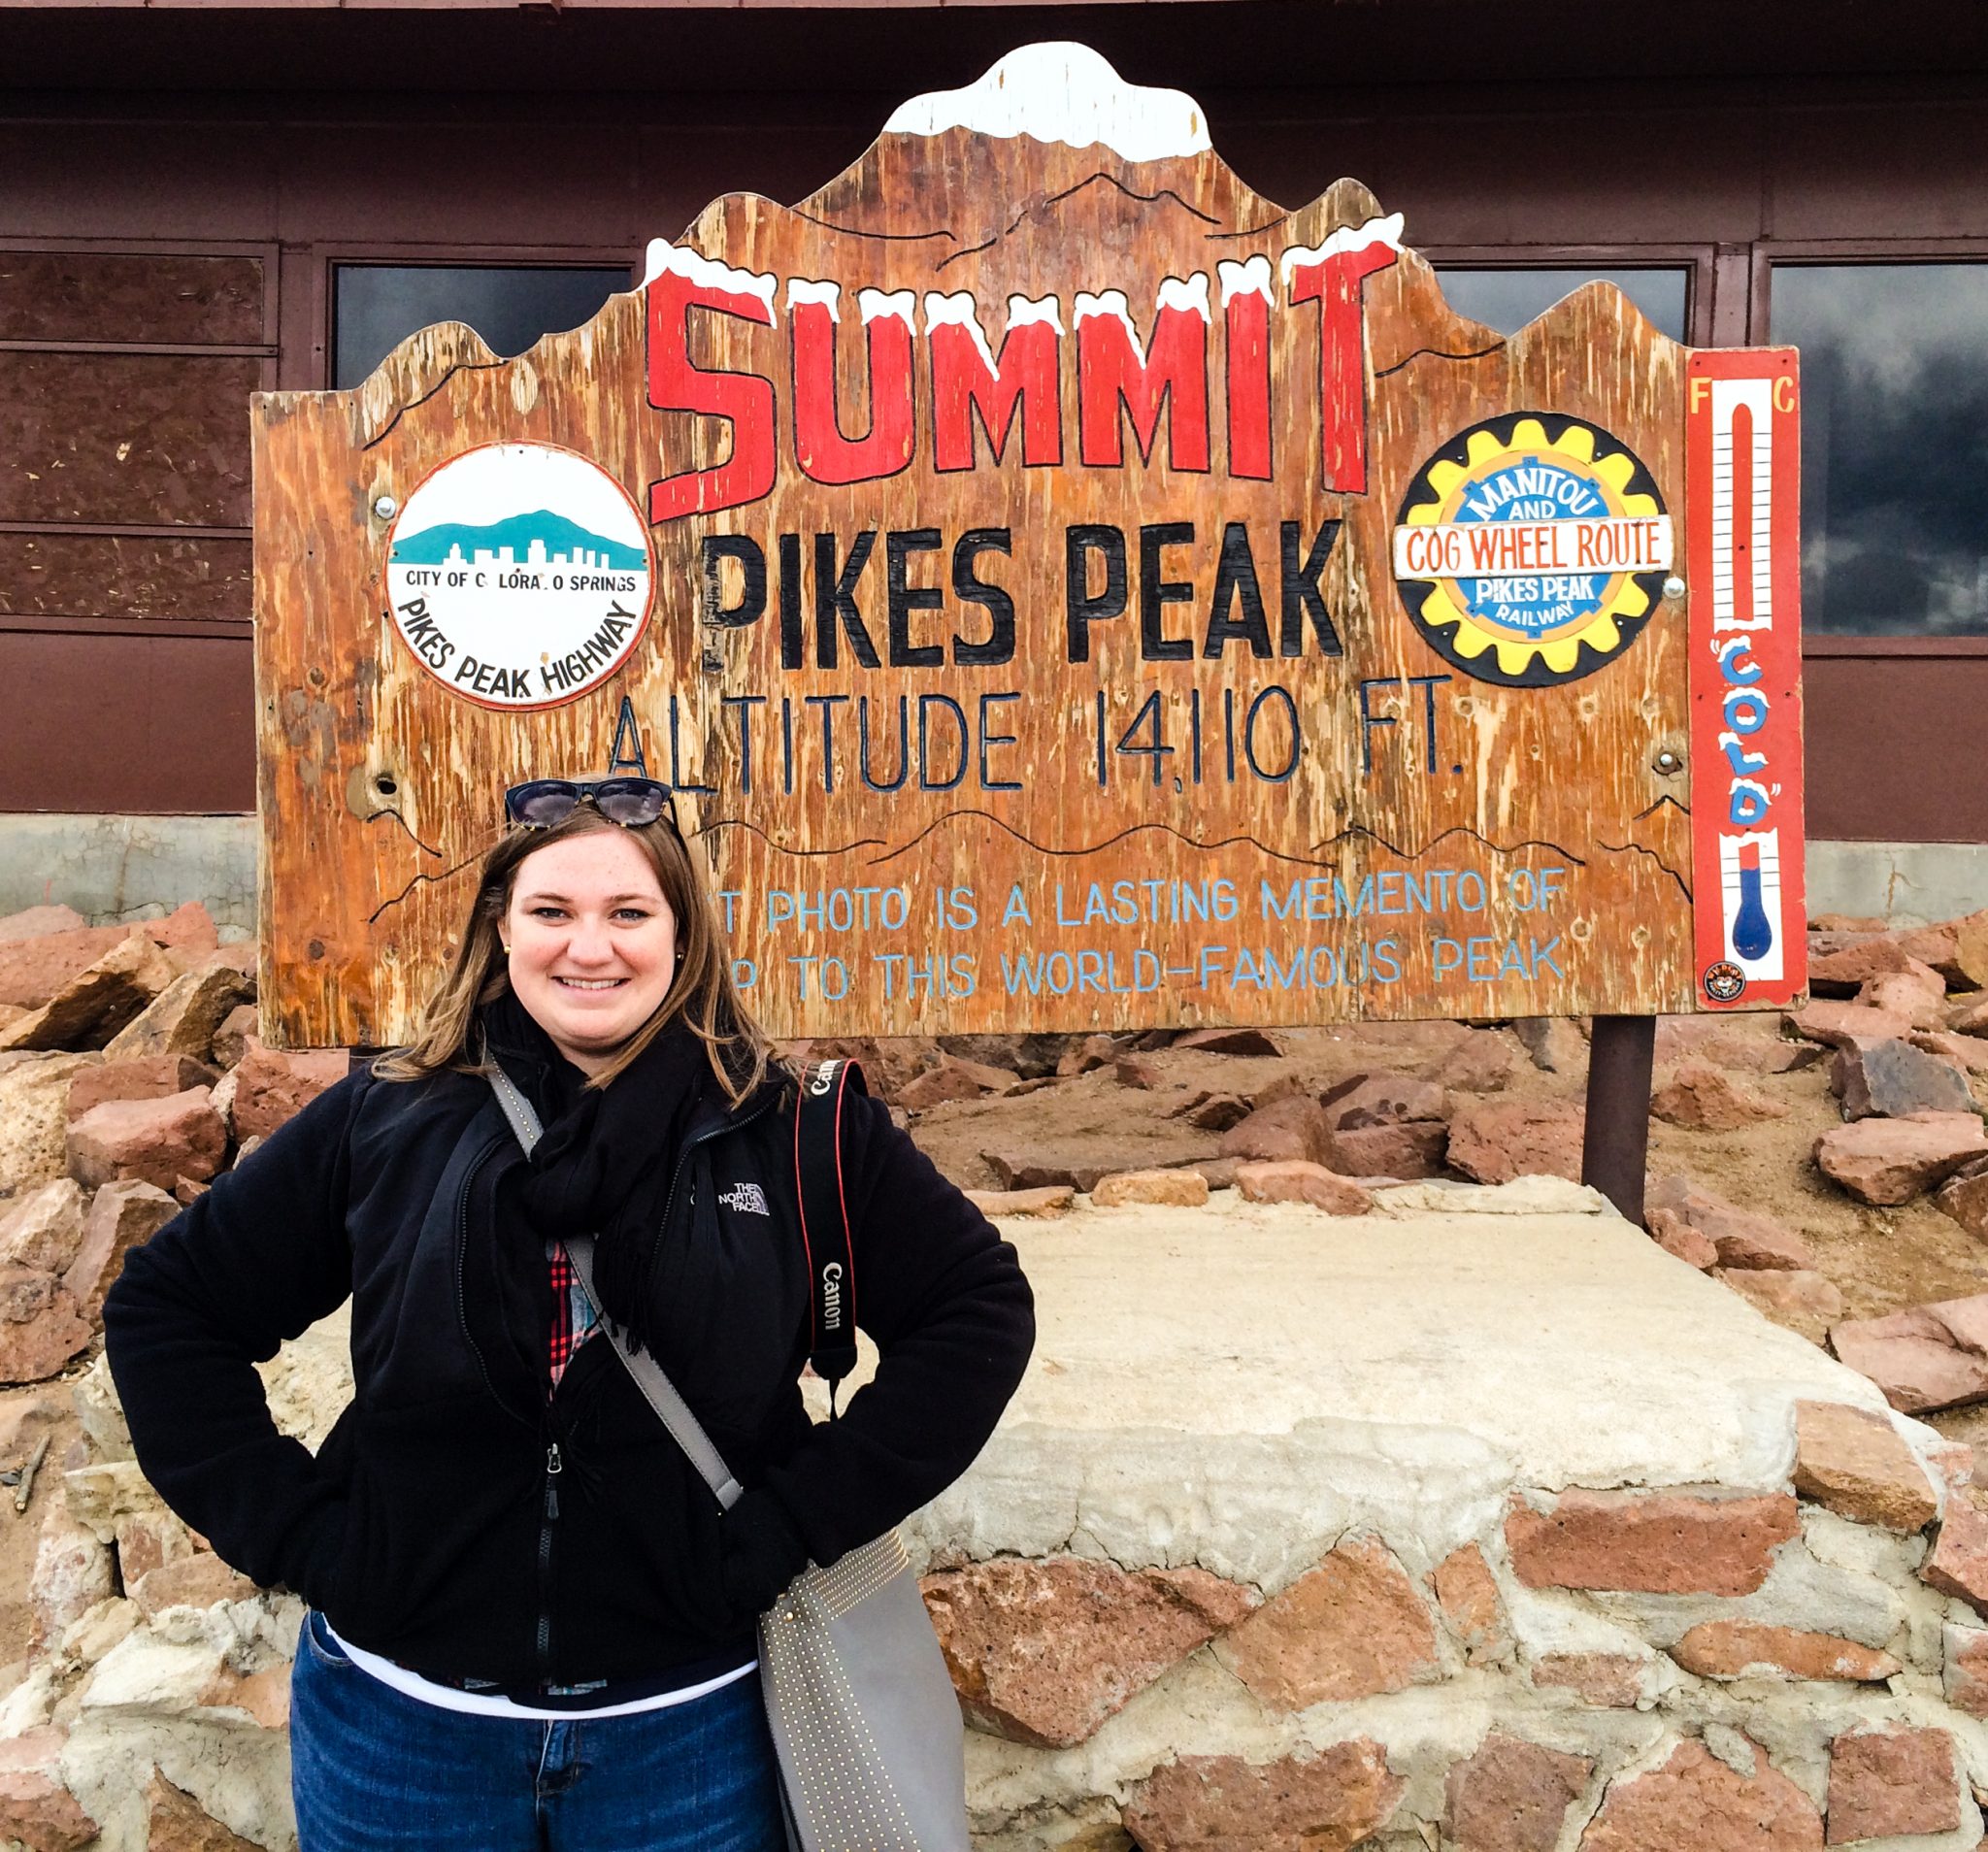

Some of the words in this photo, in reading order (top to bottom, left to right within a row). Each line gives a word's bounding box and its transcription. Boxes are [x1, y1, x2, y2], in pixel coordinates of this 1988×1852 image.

[645, 214, 1404, 525] SUMMIT
[1691, 377, 1711, 414] F
[1773, 376, 1795, 413] C
[1467, 467, 1599, 522] MANITOU
[1508, 501, 1556, 520] AND
[1407, 531, 1461, 572] COG
[1467, 525, 1568, 571] WHEEL
[1577, 521, 1662, 568] ROUTE
[406, 570, 442, 586] CITY
[447, 572, 468, 587] OF
[476, 572, 564, 590] CLORAO
[570, 576, 637, 592] SPRINGS
[702, 526, 1016, 672] PIKES
[1066, 518, 1343, 663] PEAK
[1475, 579, 1540, 605] PIKES
[1541, 576, 1595, 602] PEAK
[1495, 598, 1575, 627] RAILWAY
[398, 597, 456, 670] PIKES
[454, 655, 532, 698] PEAK
[540, 600, 637, 695] HIGHWAY
[609, 691, 1024, 796] ALTITUDE
[1097, 684, 1301, 794] 14,110
[1360, 674, 1464, 775] FT.
[768, 886, 907, 933] PHOTO
[937, 885, 978, 931] IS
[1001, 884, 1033, 927] A
[1056, 878, 1239, 926] LASTING
[1261, 869, 1487, 921] MEMENTO
[1508, 867, 1565, 912] OF
[787, 955, 850, 1002] TO
[874, 952, 977, 1000] THIS
[1433, 935, 1565, 983] PEAK
[718, 1192, 757, 1204] NORTH
[732, 1202, 759, 1212] FACE
[734, 1182, 757, 1194] THE
[822, 1262, 843, 1330] Canon
